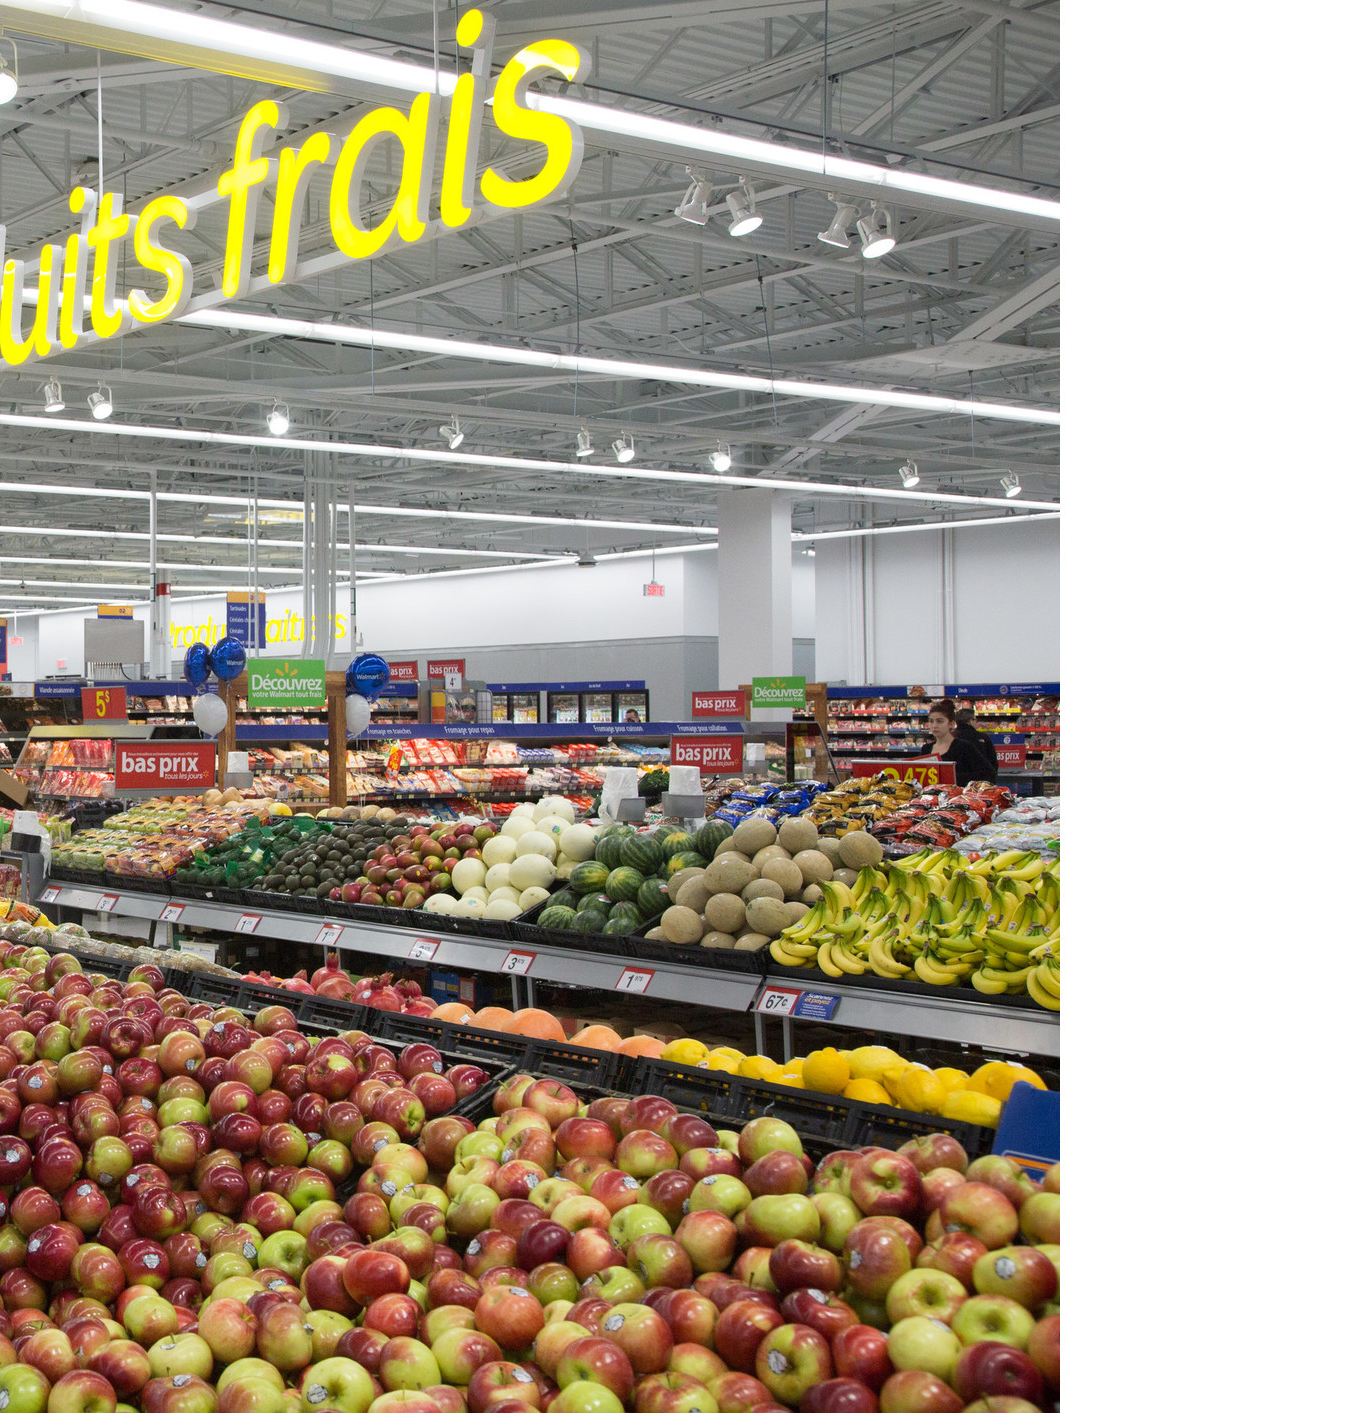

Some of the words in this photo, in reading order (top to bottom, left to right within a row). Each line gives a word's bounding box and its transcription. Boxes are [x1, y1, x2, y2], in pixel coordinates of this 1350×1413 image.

[219, 9, 587, 301] frais
[390, 667, 398, 676] as
[399, 667, 412, 677] prix
[430, 665, 442, 674] bas
[251, 674, 323, 690] Découvrez
[754, 686, 804, 698] Découvrez
[96, 691, 109, 716] 5$
[695, 697, 713, 709] bas
[715, 699, 736, 711] prix
[367, 728, 384, 736] Fromage
[444, 726, 468, 735] Fromage
[469, 727, 480, 735] pour
[480, 727, 495, 735] repas
[593, 724, 614, 733] Fromage
[676, 725, 698, 733] Fromage
[676, 743, 701, 761] bas
[703, 747, 731, 765] prix
[1005, 753, 1019, 762] prix
[121, 752, 156, 773] bas
[159, 757, 199, 778] prix
[187, 772, 203, 781] jours
